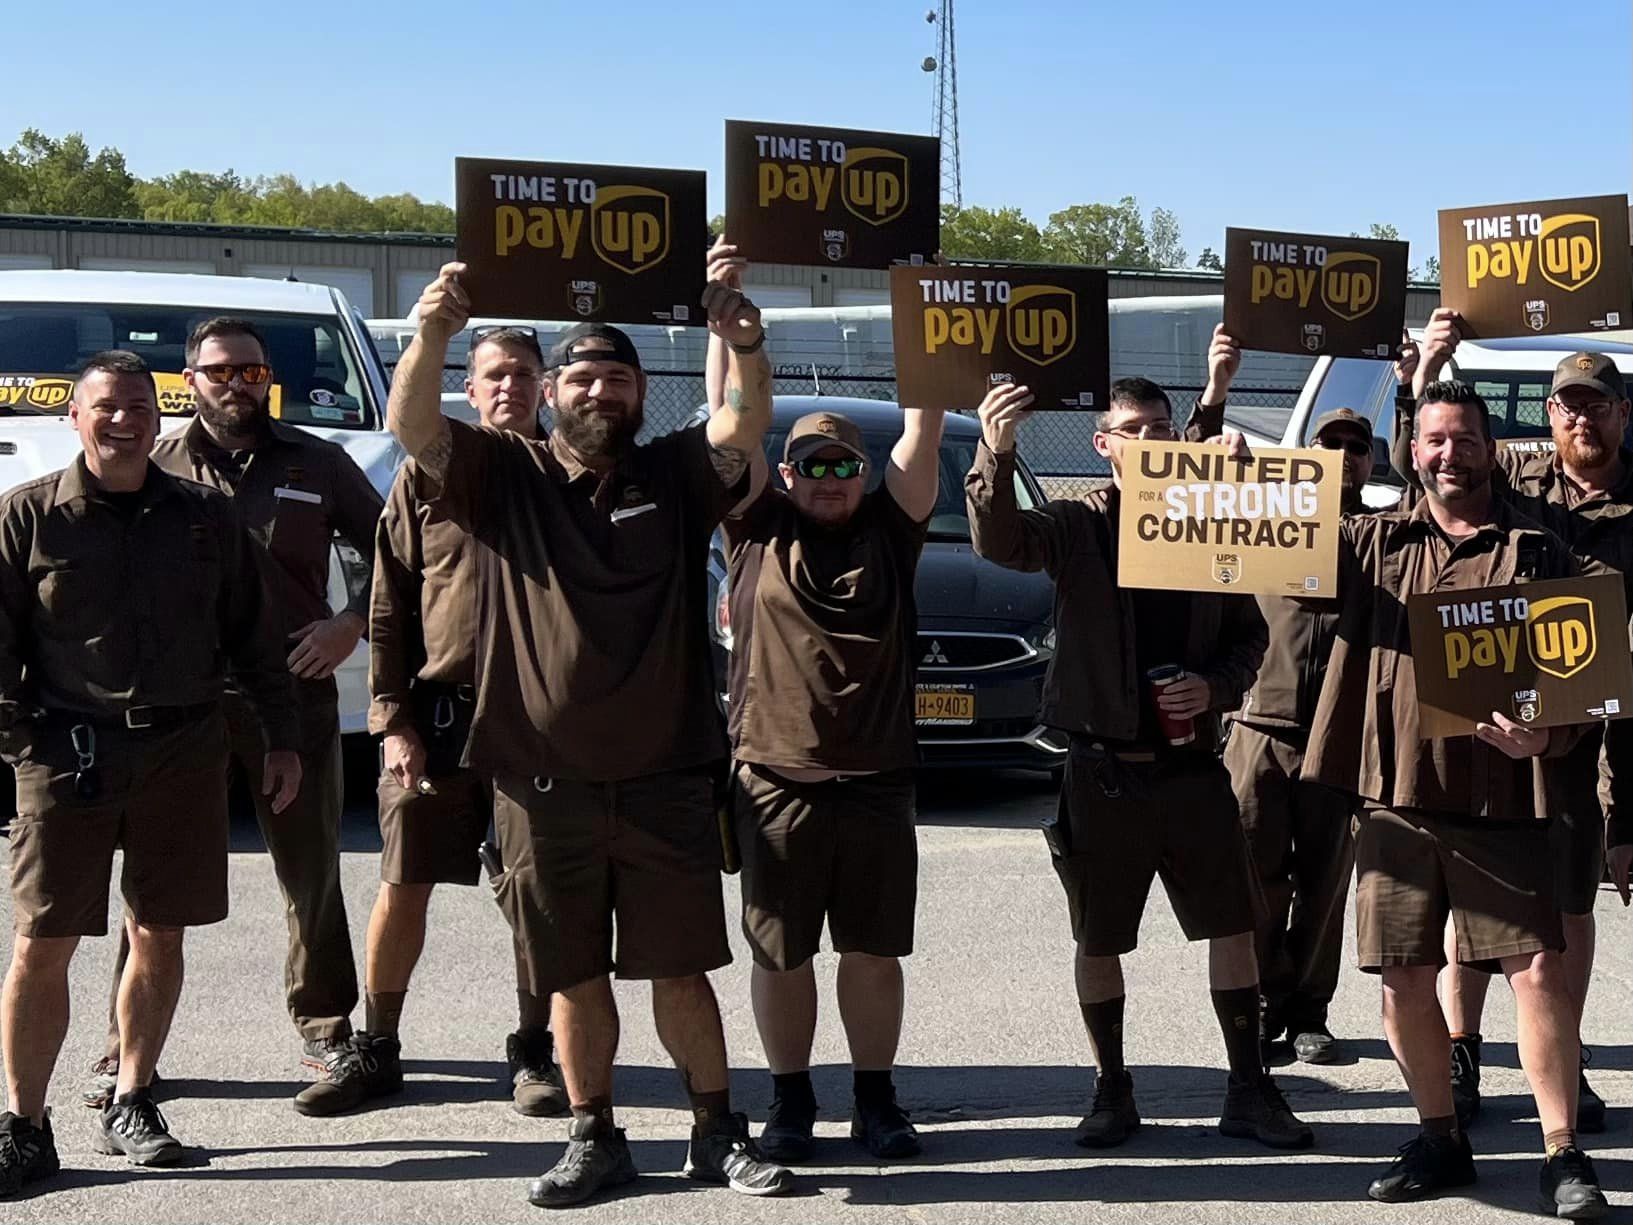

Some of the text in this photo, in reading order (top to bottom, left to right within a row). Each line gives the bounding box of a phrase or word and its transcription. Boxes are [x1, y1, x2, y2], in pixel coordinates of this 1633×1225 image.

[755, 135, 846, 164] TIME TO
[490, 174, 596, 204] TIME TO
[759, 162, 900, 216] pay up
[495, 205, 660, 262] pay up
[823, 229, 845, 239] UPS
[1463, 213, 1542, 241] TIME TO
[1250, 241, 1328, 266] TIME TO
[1467, 235, 1593, 288] pay up
[571, 280, 596, 290] UPS
[919, 279, 1011, 304] TIME TO
[1251, 264, 1372, 312] pay up
[1525, 300, 1545, 309] UPS
[924, 307, 1067, 355] pay up
[17, 377, 36, 387] TO
[990, 372, 1012, 382] UPS
[0, 387, 66, 404] ay up
[1507, 442, 1557, 452] TIME TO
[1140, 451, 1324, 485] UNITED
[1139, 481, 1318, 521] FOR A STRONG
[1137, 513, 1320, 549] CONTRACT
[1216, 553, 1238, 562] UPS
[1437, 597, 1529, 628] TIME TO
[1444, 619, 1588, 679] pay up
[1515, 689, 1537, 699] UPS
